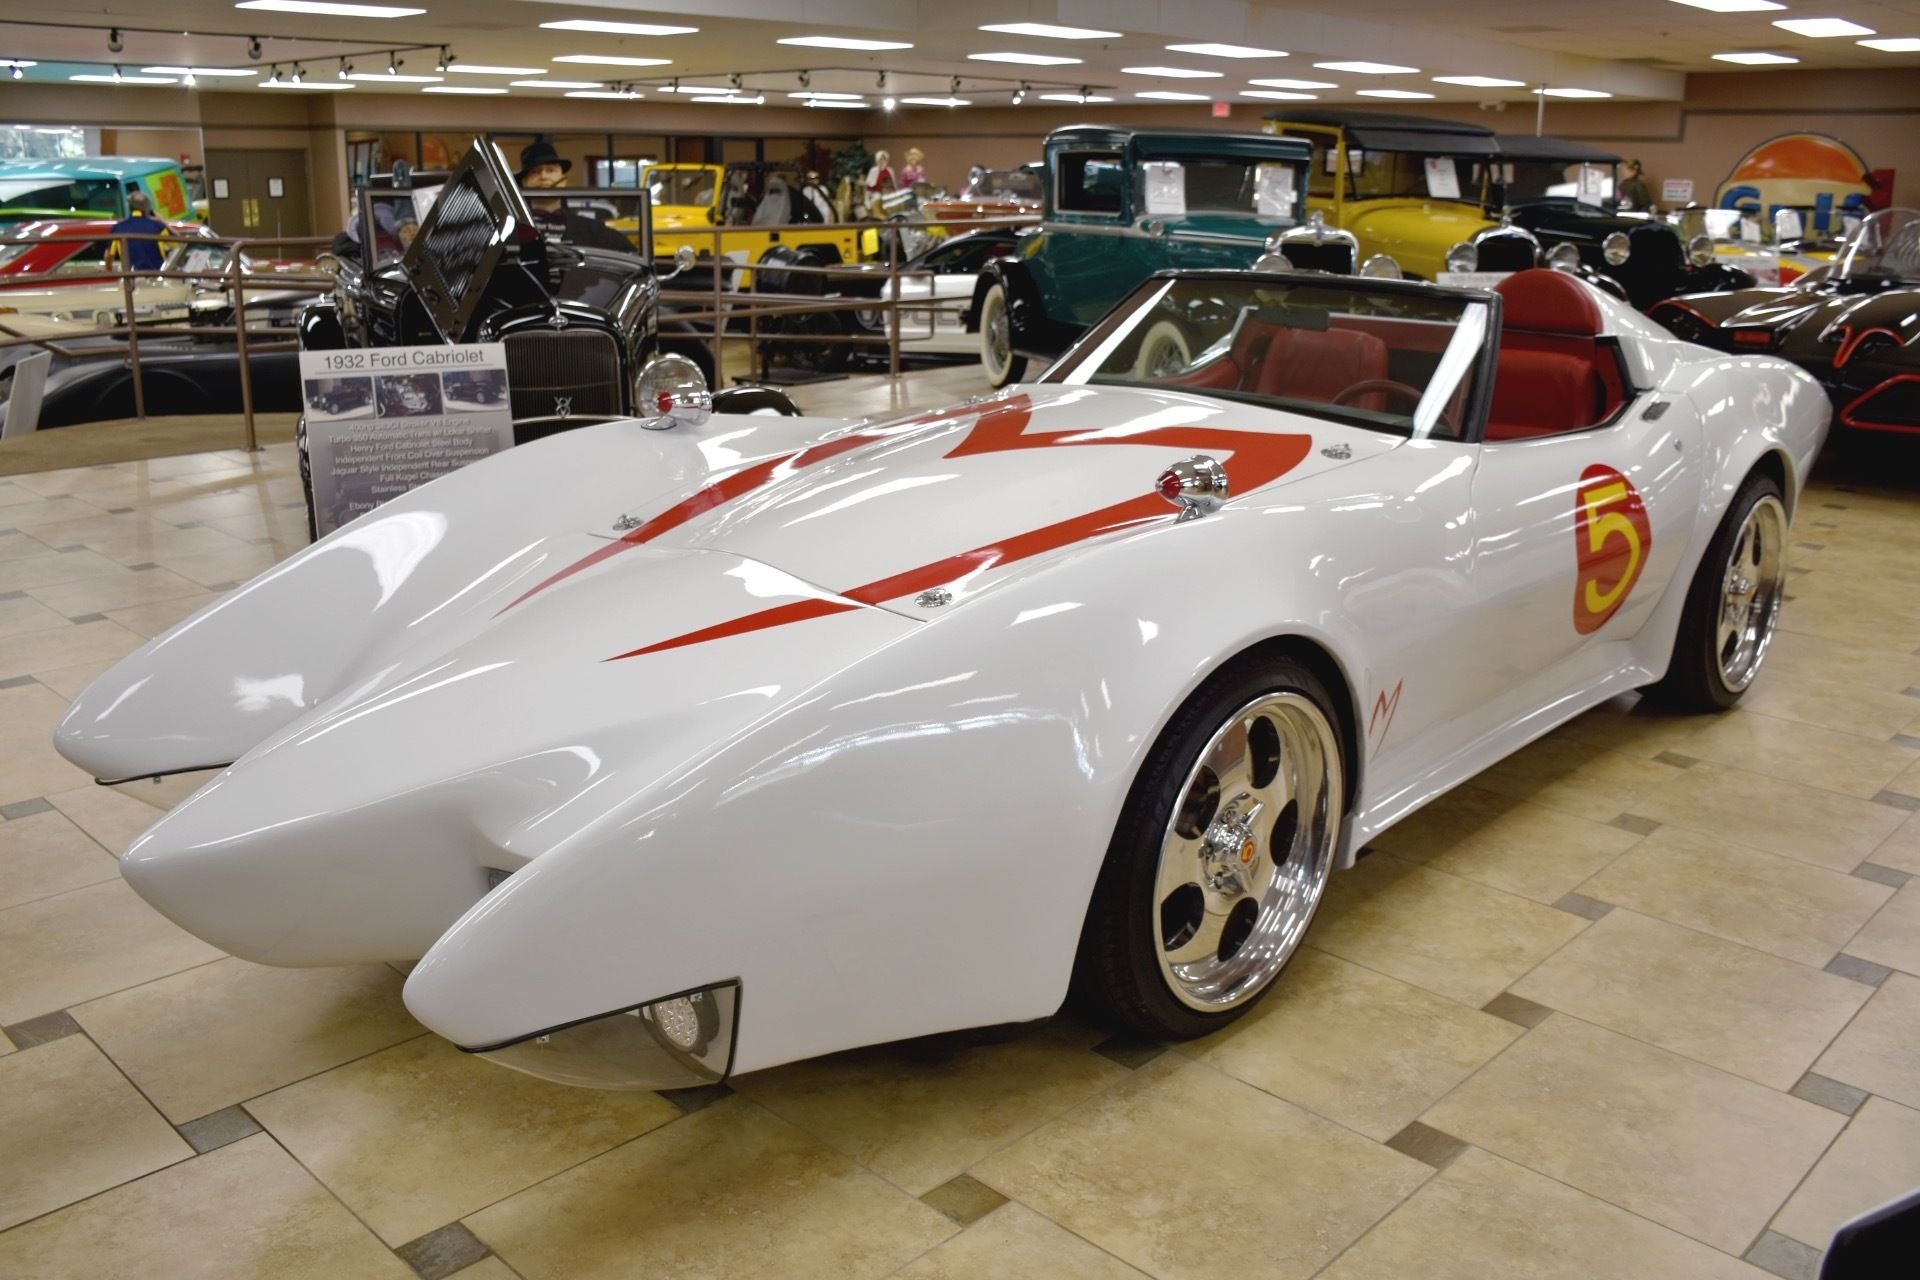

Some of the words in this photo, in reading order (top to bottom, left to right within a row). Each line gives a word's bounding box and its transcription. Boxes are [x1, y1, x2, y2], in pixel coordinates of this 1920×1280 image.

[325, 355, 364, 370] 1932
[371, 352, 407, 367] Ford
[412, 349, 484, 365] Cabriolet
[350, 444, 374, 453] Henry
[376, 442, 394, 450] Ford
[395, 439, 430, 449] Cabriolet
[431, 438, 452, 447] Steel
[453, 438, 472, 447] Body
[335, 454, 384, 464] Independent
[385, 452, 406, 461] Front
[408, 450, 423, 459] Coil
[424, 450, 443, 458] Over
[445, 446, 489, 457] Suspension
[331, 466, 358, 476] Jaguar
[359, 465, 379, 475] Style
[381, 461, 429, 472] Independent
[431, 460, 449, 468] Rear
[380, 473, 394, 482] Full
[396, 472, 418, 483] Kugel
[372, 484, 407, 494] Stainless
[349, 502, 374, 512] Ebony
[1583, 480, 1641, 614] 5
[1368, 678, 1404, 765] M
